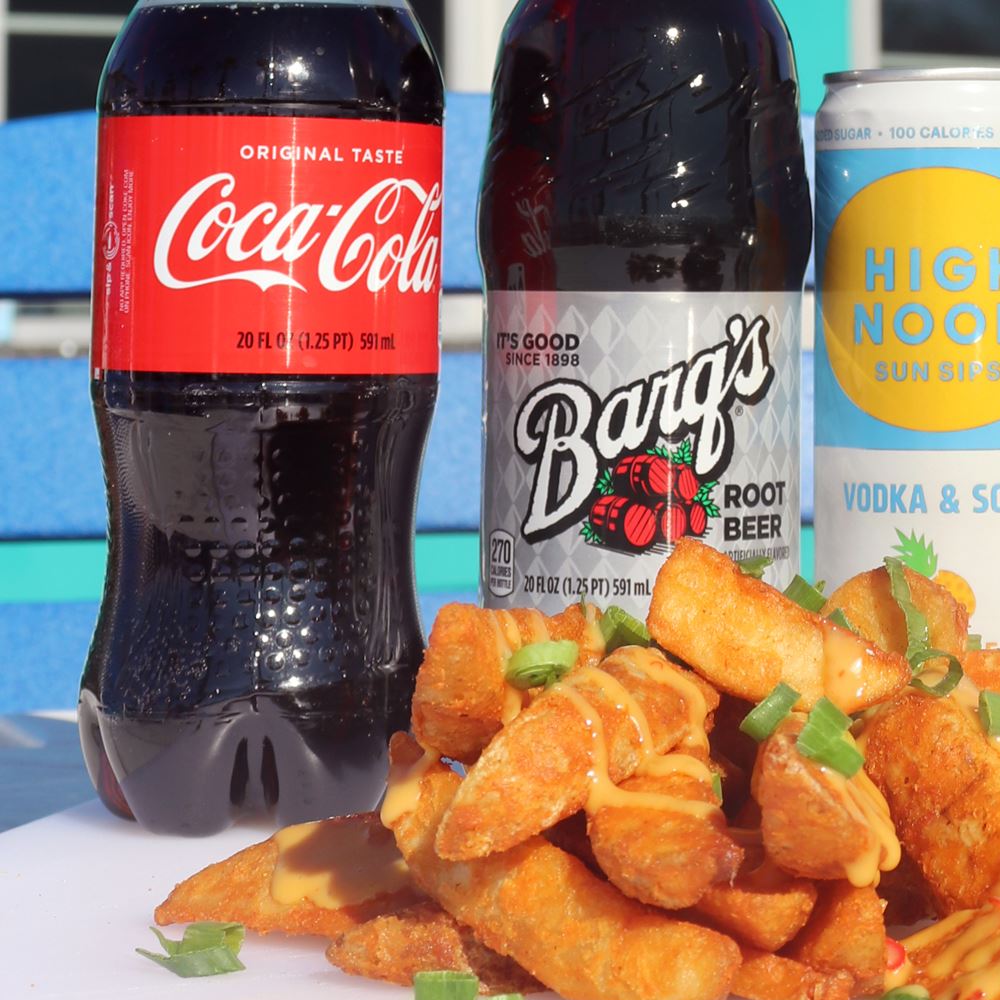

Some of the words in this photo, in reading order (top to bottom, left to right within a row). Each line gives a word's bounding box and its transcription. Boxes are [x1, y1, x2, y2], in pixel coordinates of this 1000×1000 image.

[834, 128, 871, 141] SUGAR
[890, 127, 915, 139] 100
[240, 145, 344, 162] ORIGINAL
[352, 148, 404, 164] TASTE
[153, 172, 443, 293] Coca-Cola
[236, 332, 254, 349] 20
[258, 332, 272, 349] FL
[298, 332, 330, 351] (1.25
[332, 332, 353, 351] PT)
[360, 332, 378, 350] 591
[380, 334, 396, 349] mL
[496, 333, 518, 348] IT'S
[522, 333, 580, 351] GOOD
[505, 352, 541, 366] SINCE
[545, 353, 580, 367] 1898
[875, 361, 929, 381] SUN
[515, 315, 774, 545] Barq's
[724, 481, 786, 509] ROOT
[843, 482, 928, 513] VODKA
[940, 484, 960, 513] &
[723, 514, 782, 542] BEER
[491, 539, 511, 564] 270
[524, 575, 535, 592] 20
[536, 576, 545, 593] FL
[548, 577, 559, 594] OZ
[563, 577, 588, 597] (1.25
[592, 577, 610, 597] PT)
[613, 578, 631, 595] 591
[634, 578, 651, 595] mL
